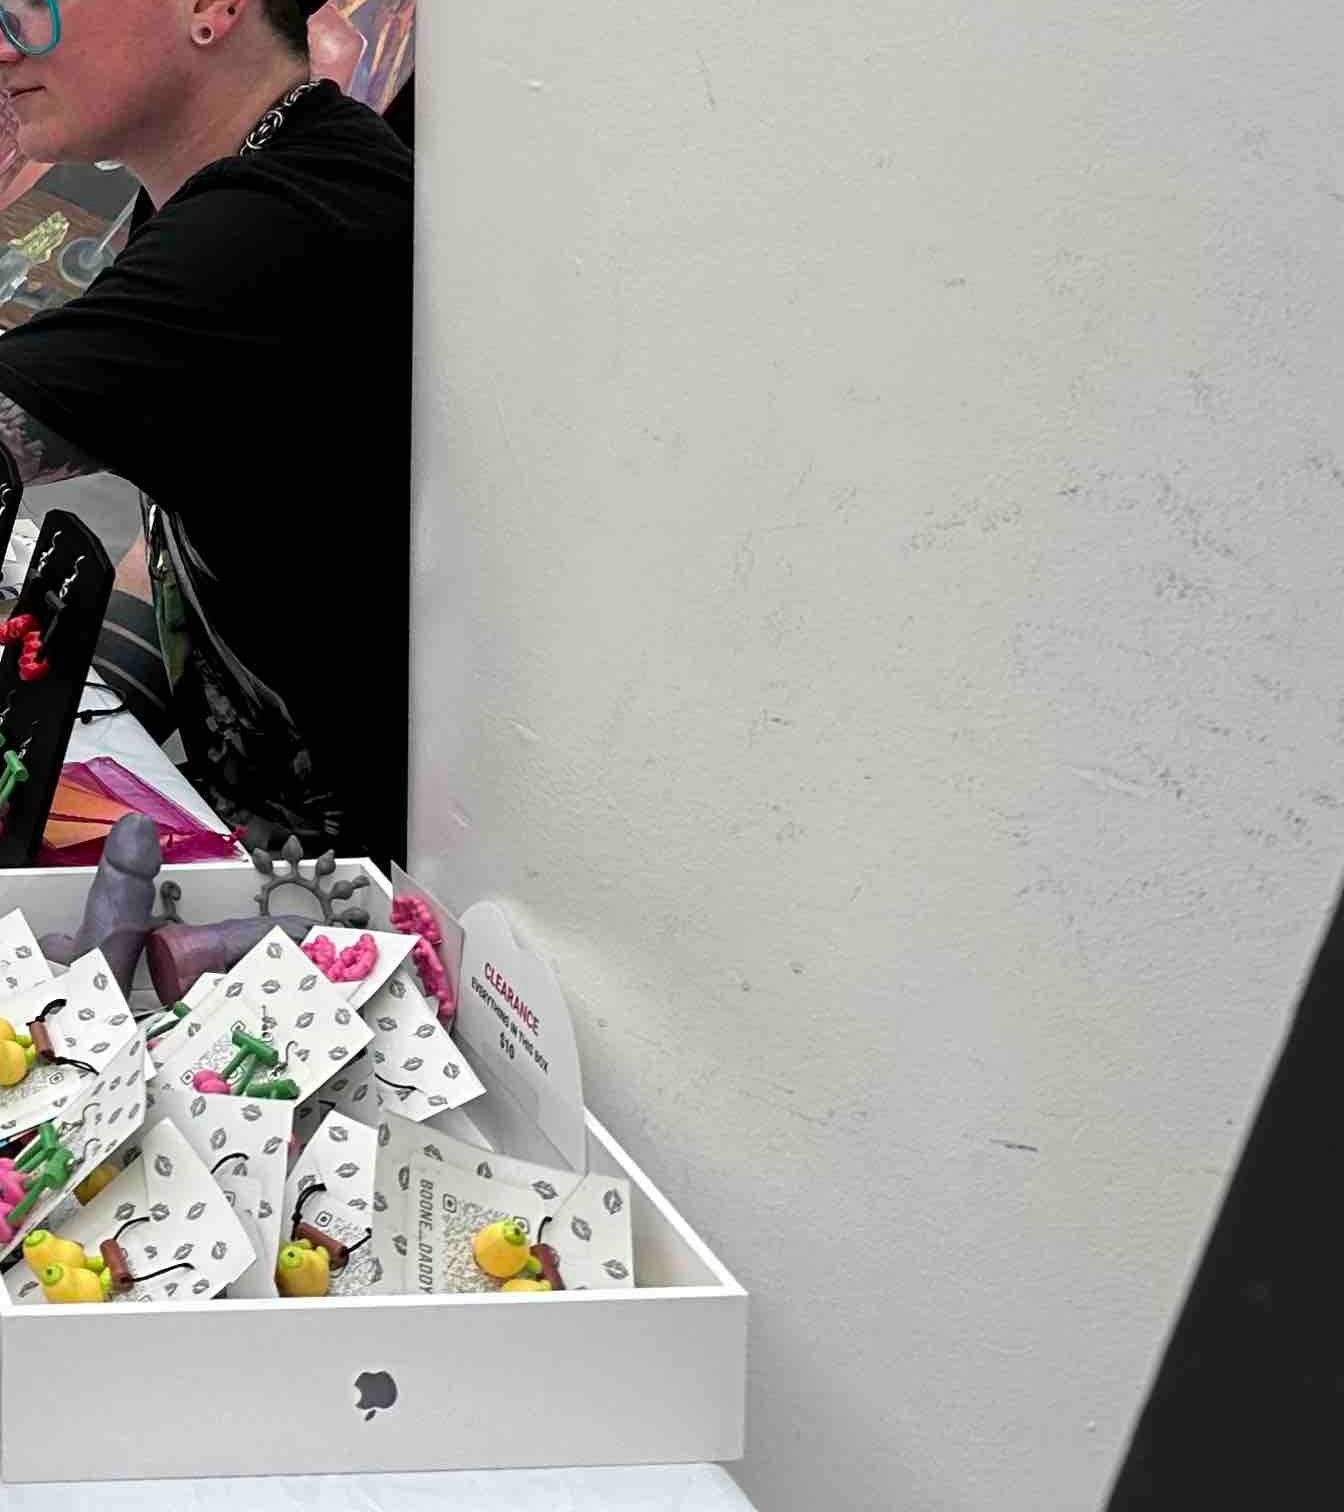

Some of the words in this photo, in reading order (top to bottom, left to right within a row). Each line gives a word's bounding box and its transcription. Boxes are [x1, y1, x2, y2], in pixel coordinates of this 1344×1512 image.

[471, 976, 510, 1029] EVERYTHING
[510, 1022, 519, 1037] IN
[518, 1028, 534, 1056] THIS
[534, 1047, 550, 1074] BOX
[483, 962, 540, 1036] CLEARANCE
[499, 1031, 515, 1060] $10
